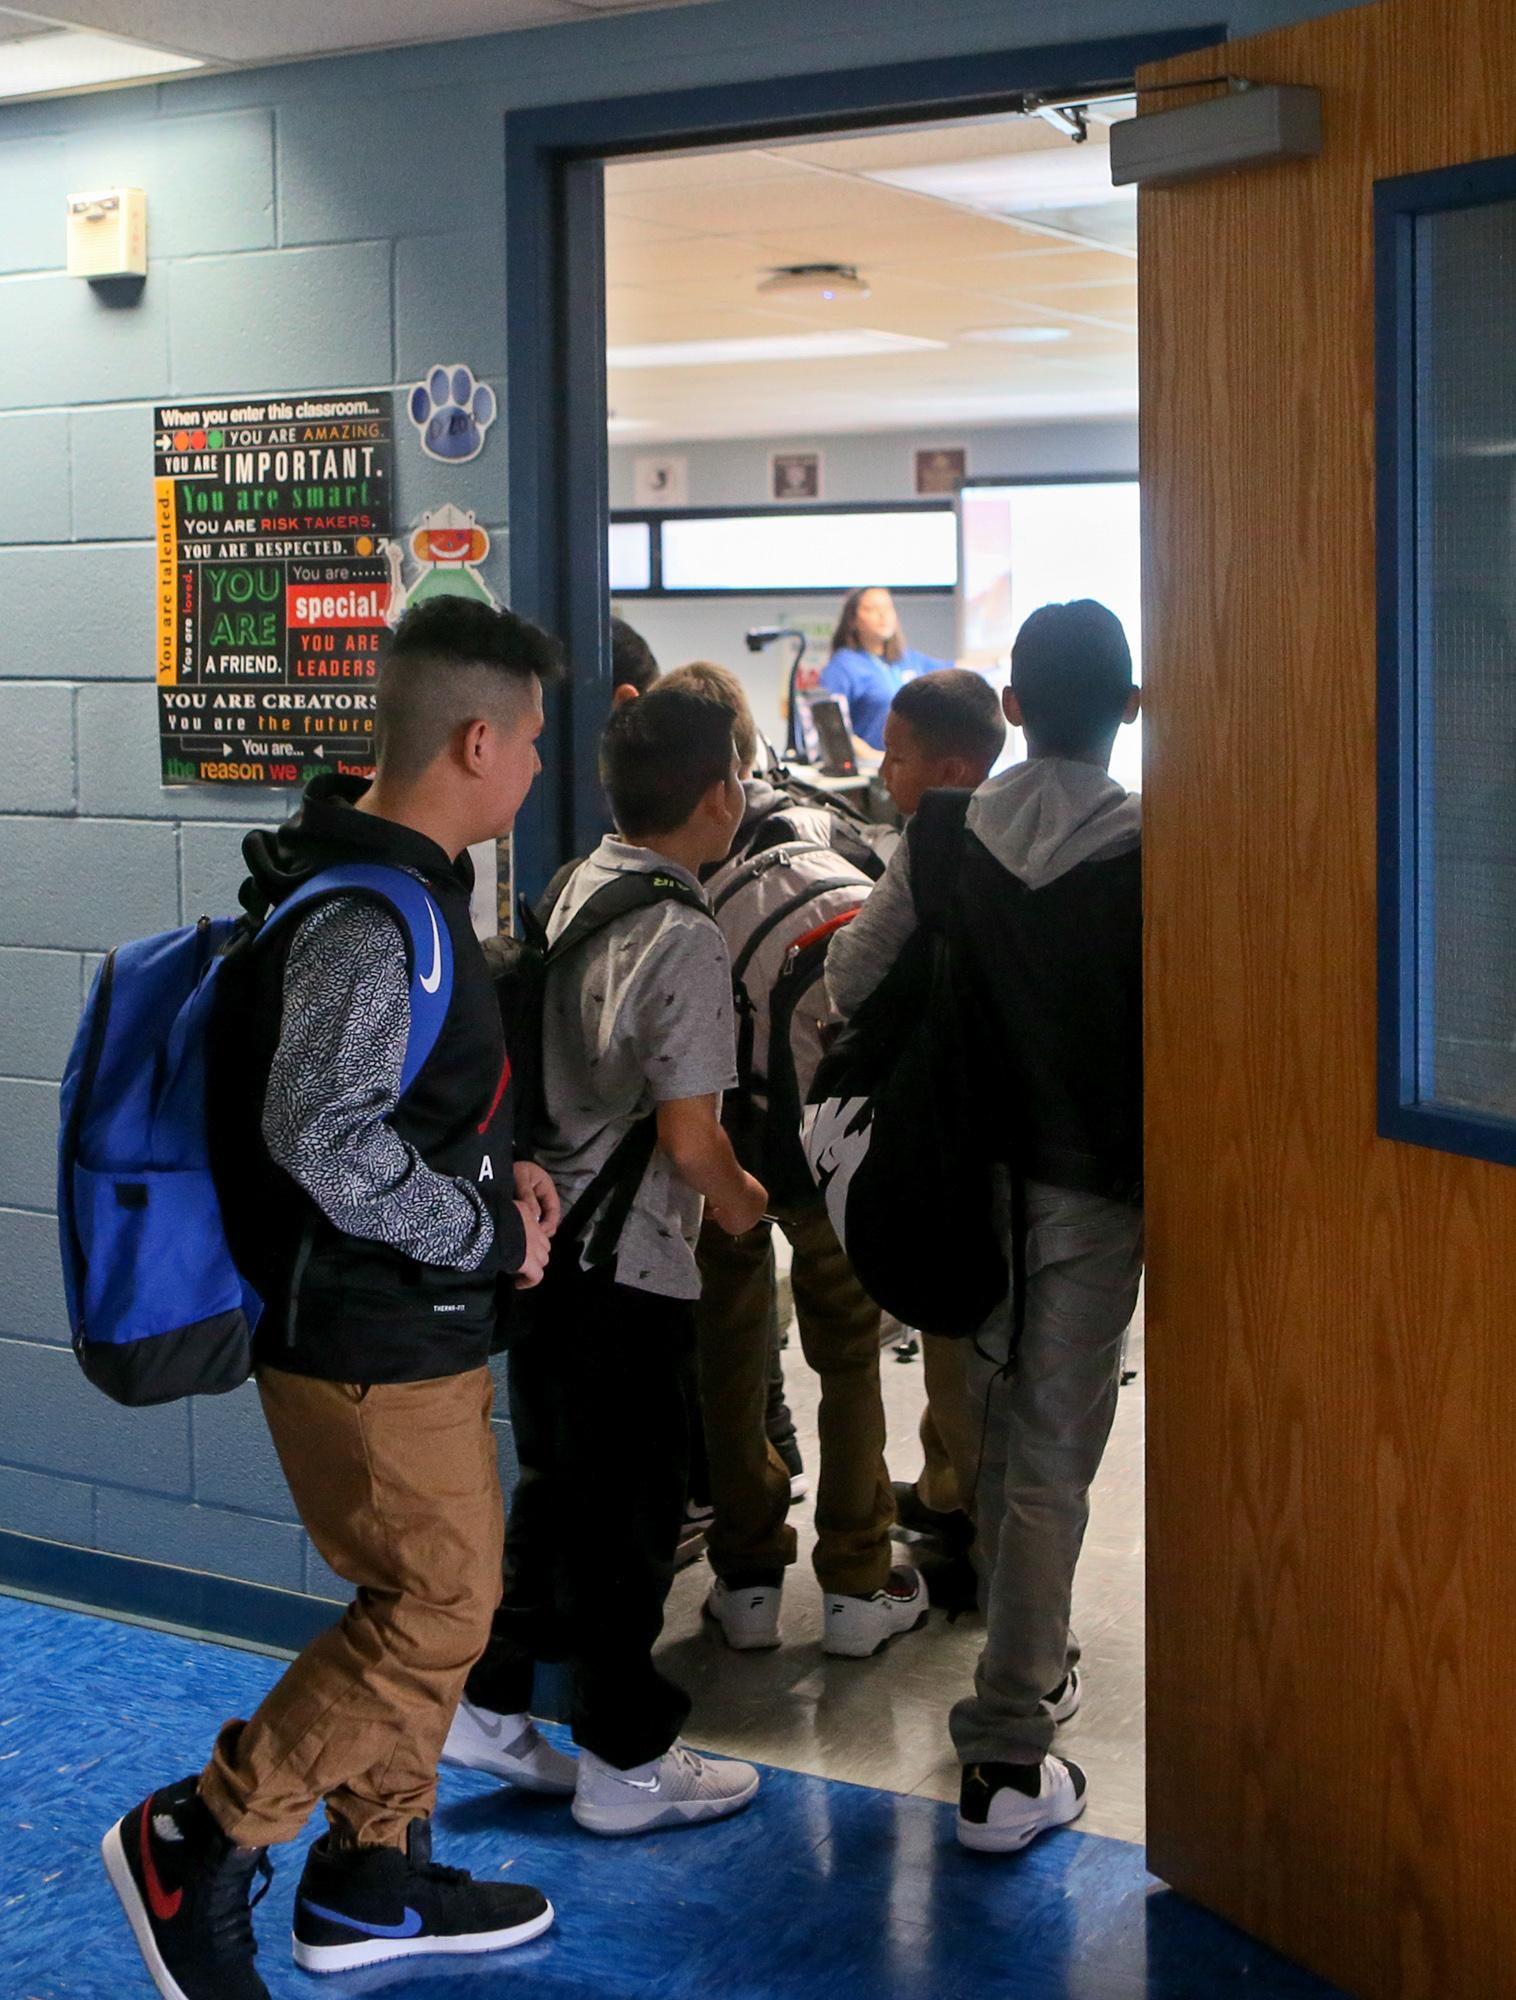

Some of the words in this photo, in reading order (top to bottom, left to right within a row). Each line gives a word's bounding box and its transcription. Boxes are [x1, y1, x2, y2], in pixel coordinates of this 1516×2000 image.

[161, 408, 200, 428] When
[202, 409, 228, 429] you
[230, 405, 266, 422] enter
[268, 402, 293, 420] this
[295, 401, 380, 419] classroom...
[230, 430, 263, 446] YOU
[268, 427, 296, 444] ARE
[303, 423, 385, 441] AMAZING.
[165, 456, 189, 473] YOU
[194, 454, 217, 472] ARE
[225, 446, 383, 485] IMPORTANT.
[183, 485, 224, 513] You
[237, 489, 278, 511] are
[293, 480, 380, 509] smart.
[184, 519, 219, 534] YOU
[223, 518, 256, 533] ARE
[261, 517, 299, 531] RISK
[304, 515, 376, 530] TAKERS.
[158, 489, 173, 586] talented.
[183, 543, 212, 559] YOU
[219, 542, 248, 558] ARE
[255, 541, 348, 557] RESPECTED.
[293, 565, 320, 580] You
[182, 569, 193, 614] loved.
[207, 568, 279, 603] YOU
[162, 595, 172, 627] are
[296, 590, 385, 625] special.
[184, 618, 193, 643] are
[209, 612, 277, 646] ARE
[160, 636, 172, 673] You
[301, 634, 334, 652] YOU
[346, 634, 379, 651] ARE
[182, 647, 193, 674] You
[205, 655, 216, 673] A
[220, 655, 282, 674] FRIEND.
[297, 660, 376, 677] LEADERS
[163, 693, 207, 708] YOU
[213, 693, 256, 709] ARE
[168, 714, 202, 730] You
[214, 717, 246, 731] are
[258, 715, 291, 731] the
[304, 715, 373, 734] future
[242, 739, 268, 755] You
[271, 743, 305, 756] are...
[167, 758, 196, 778] the
[200, 761, 265, 780] reason
[269, 763, 298, 780] we
